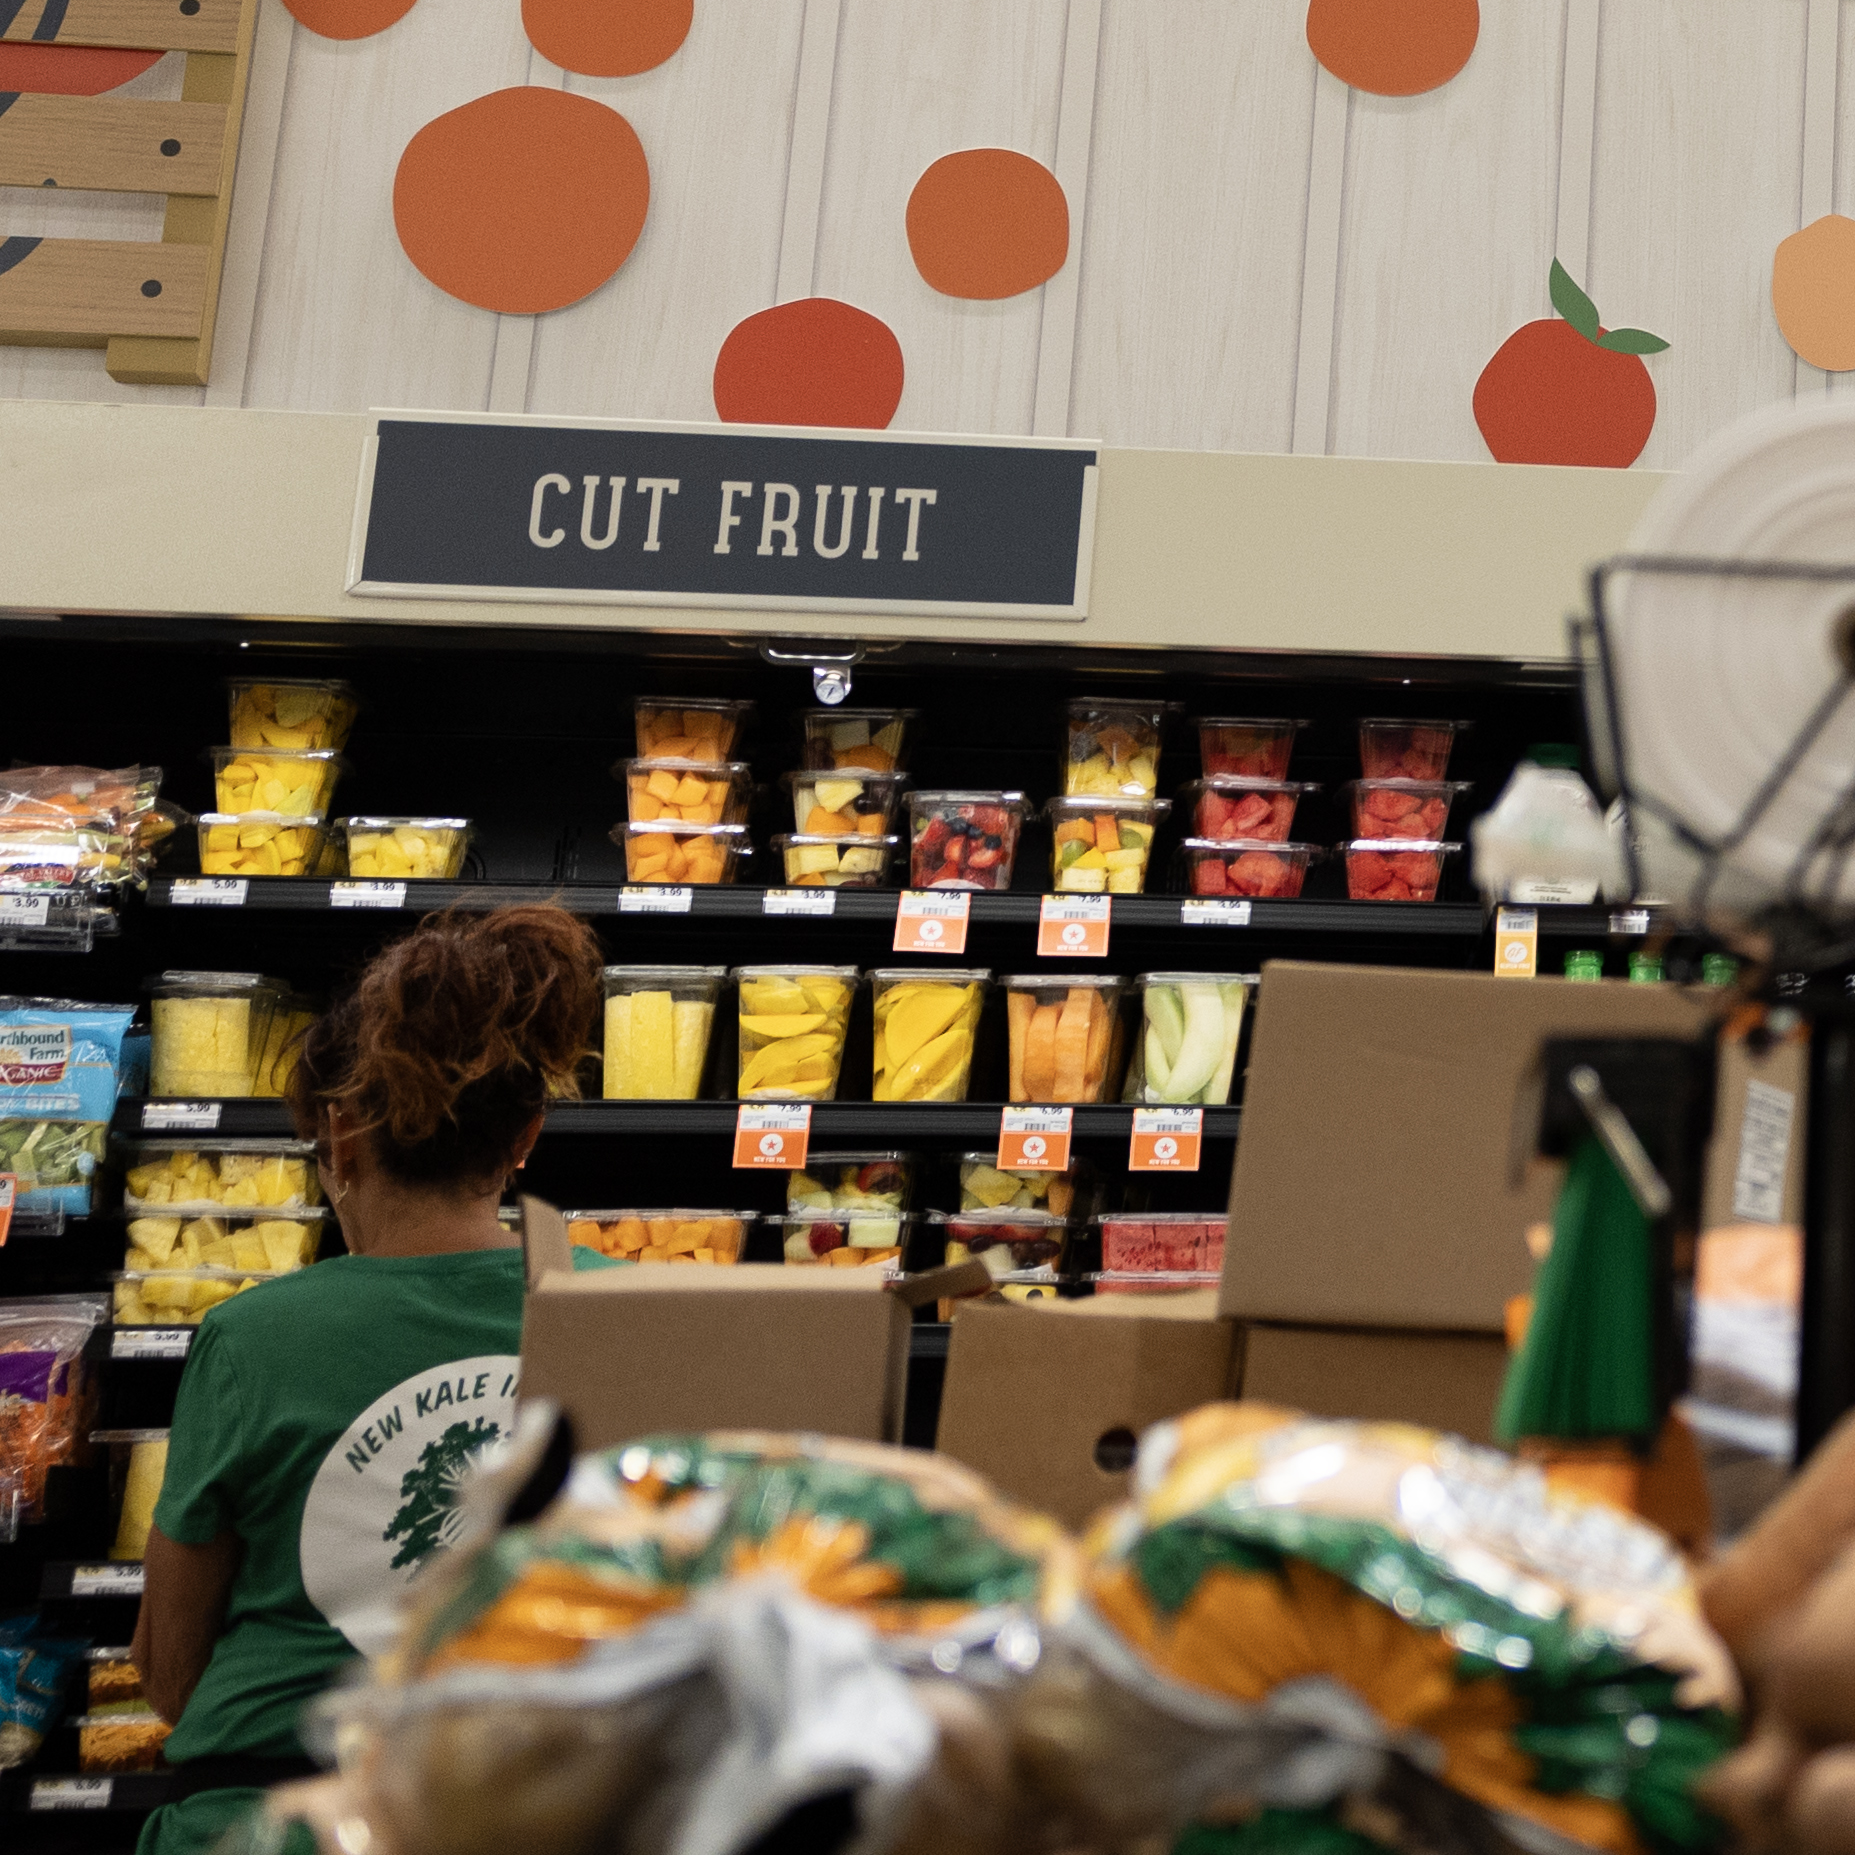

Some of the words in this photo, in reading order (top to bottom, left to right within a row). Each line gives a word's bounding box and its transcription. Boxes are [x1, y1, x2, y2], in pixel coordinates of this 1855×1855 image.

[527, 473, 681, 553] CUT
[713, 481, 938, 561] FRUIT
[30, 1048, 65, 1061] Farm
[344, 1405, 403, 1474] NEW
[415, 1372, 491, 1418] KALE
[500, 1373, 519, 1398] I
